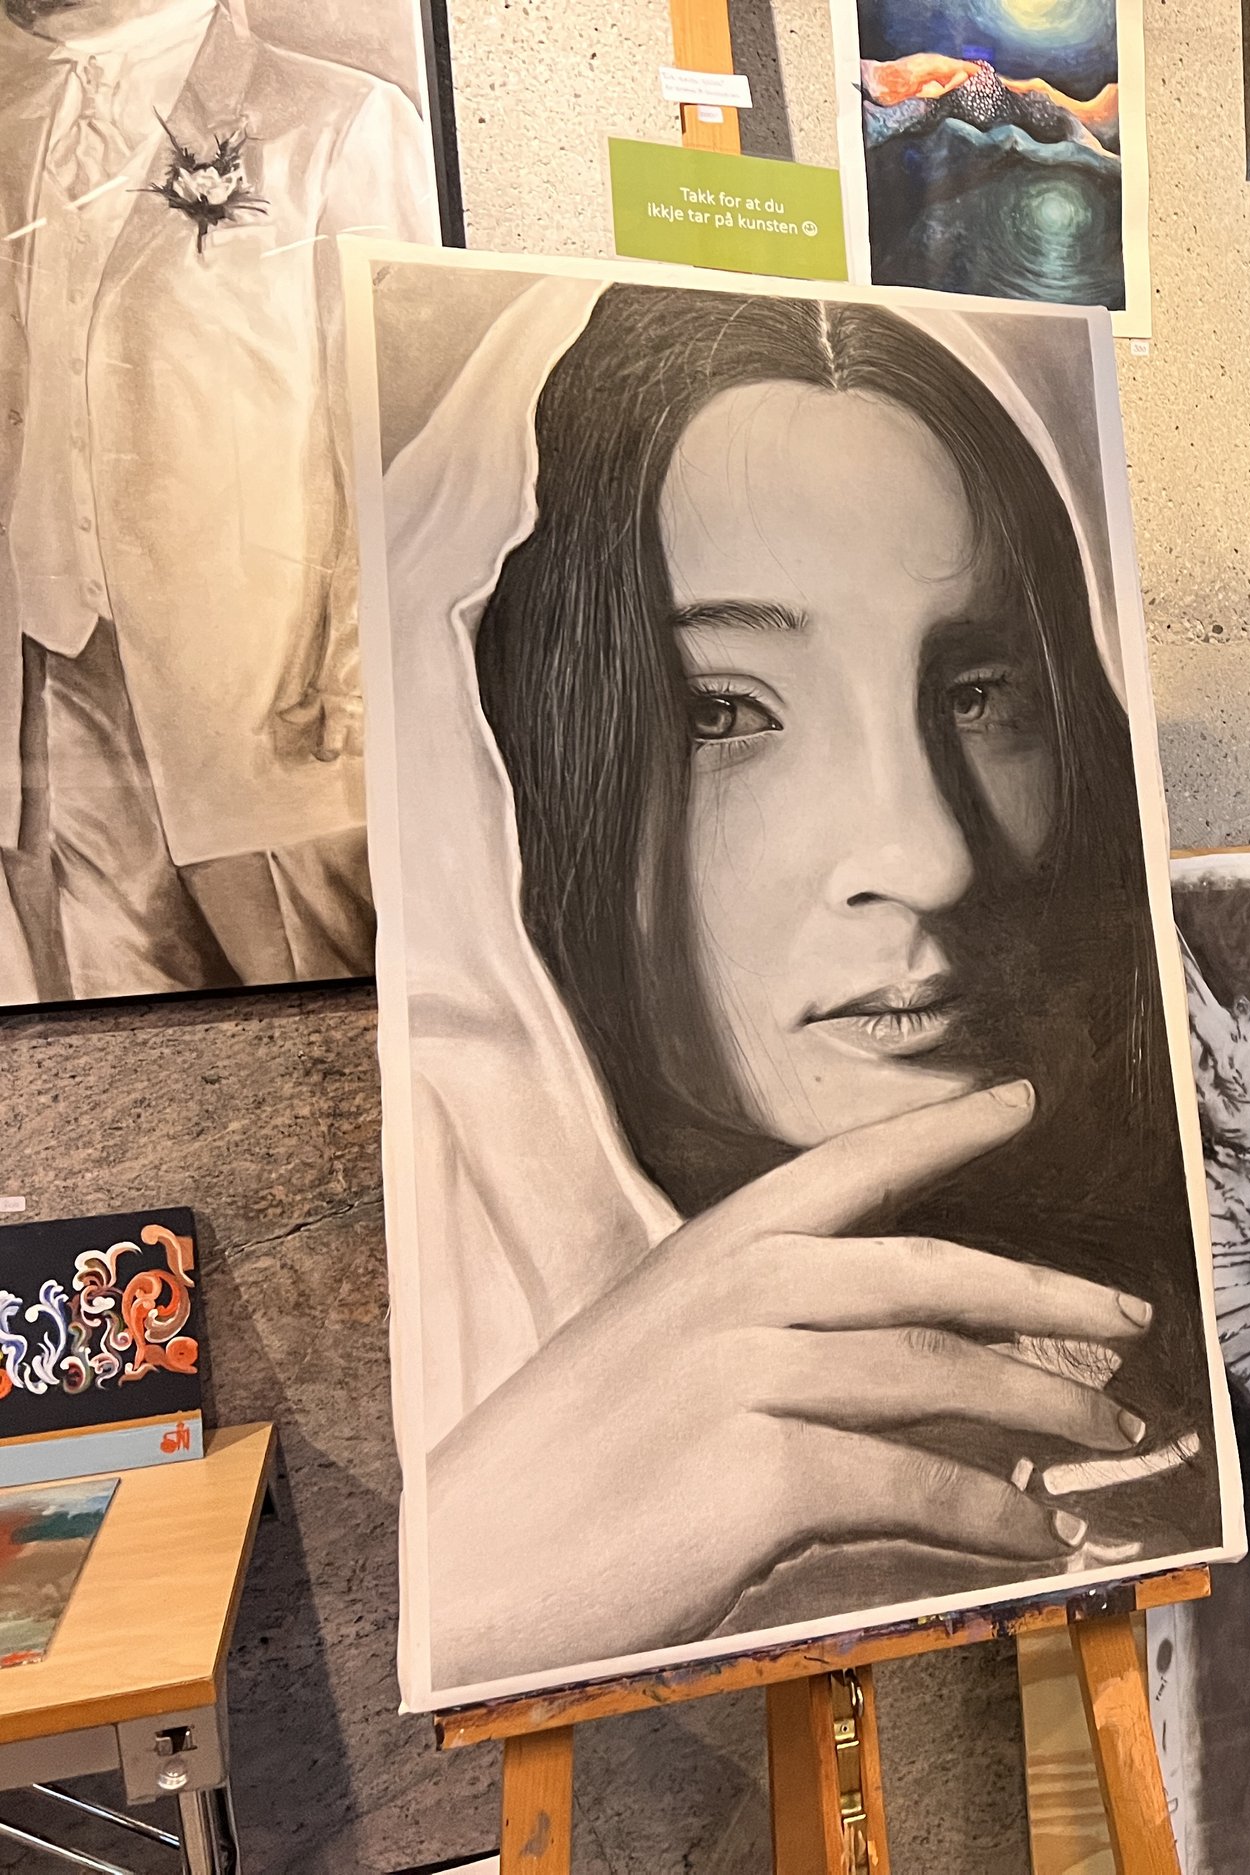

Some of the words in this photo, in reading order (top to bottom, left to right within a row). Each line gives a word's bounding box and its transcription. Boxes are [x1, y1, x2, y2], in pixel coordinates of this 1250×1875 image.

[679, 187, 716, 206] Takk
[718, 191, 742, 209] for
[745, 197, 762, 212] at
[764, 198, 785, 214] du
[647, 202, 684, 223] ikkje
[687, 208, 711, 224] tar
[714, 212, 734, 228] på
[737, 213, 799, 235] kunsten
